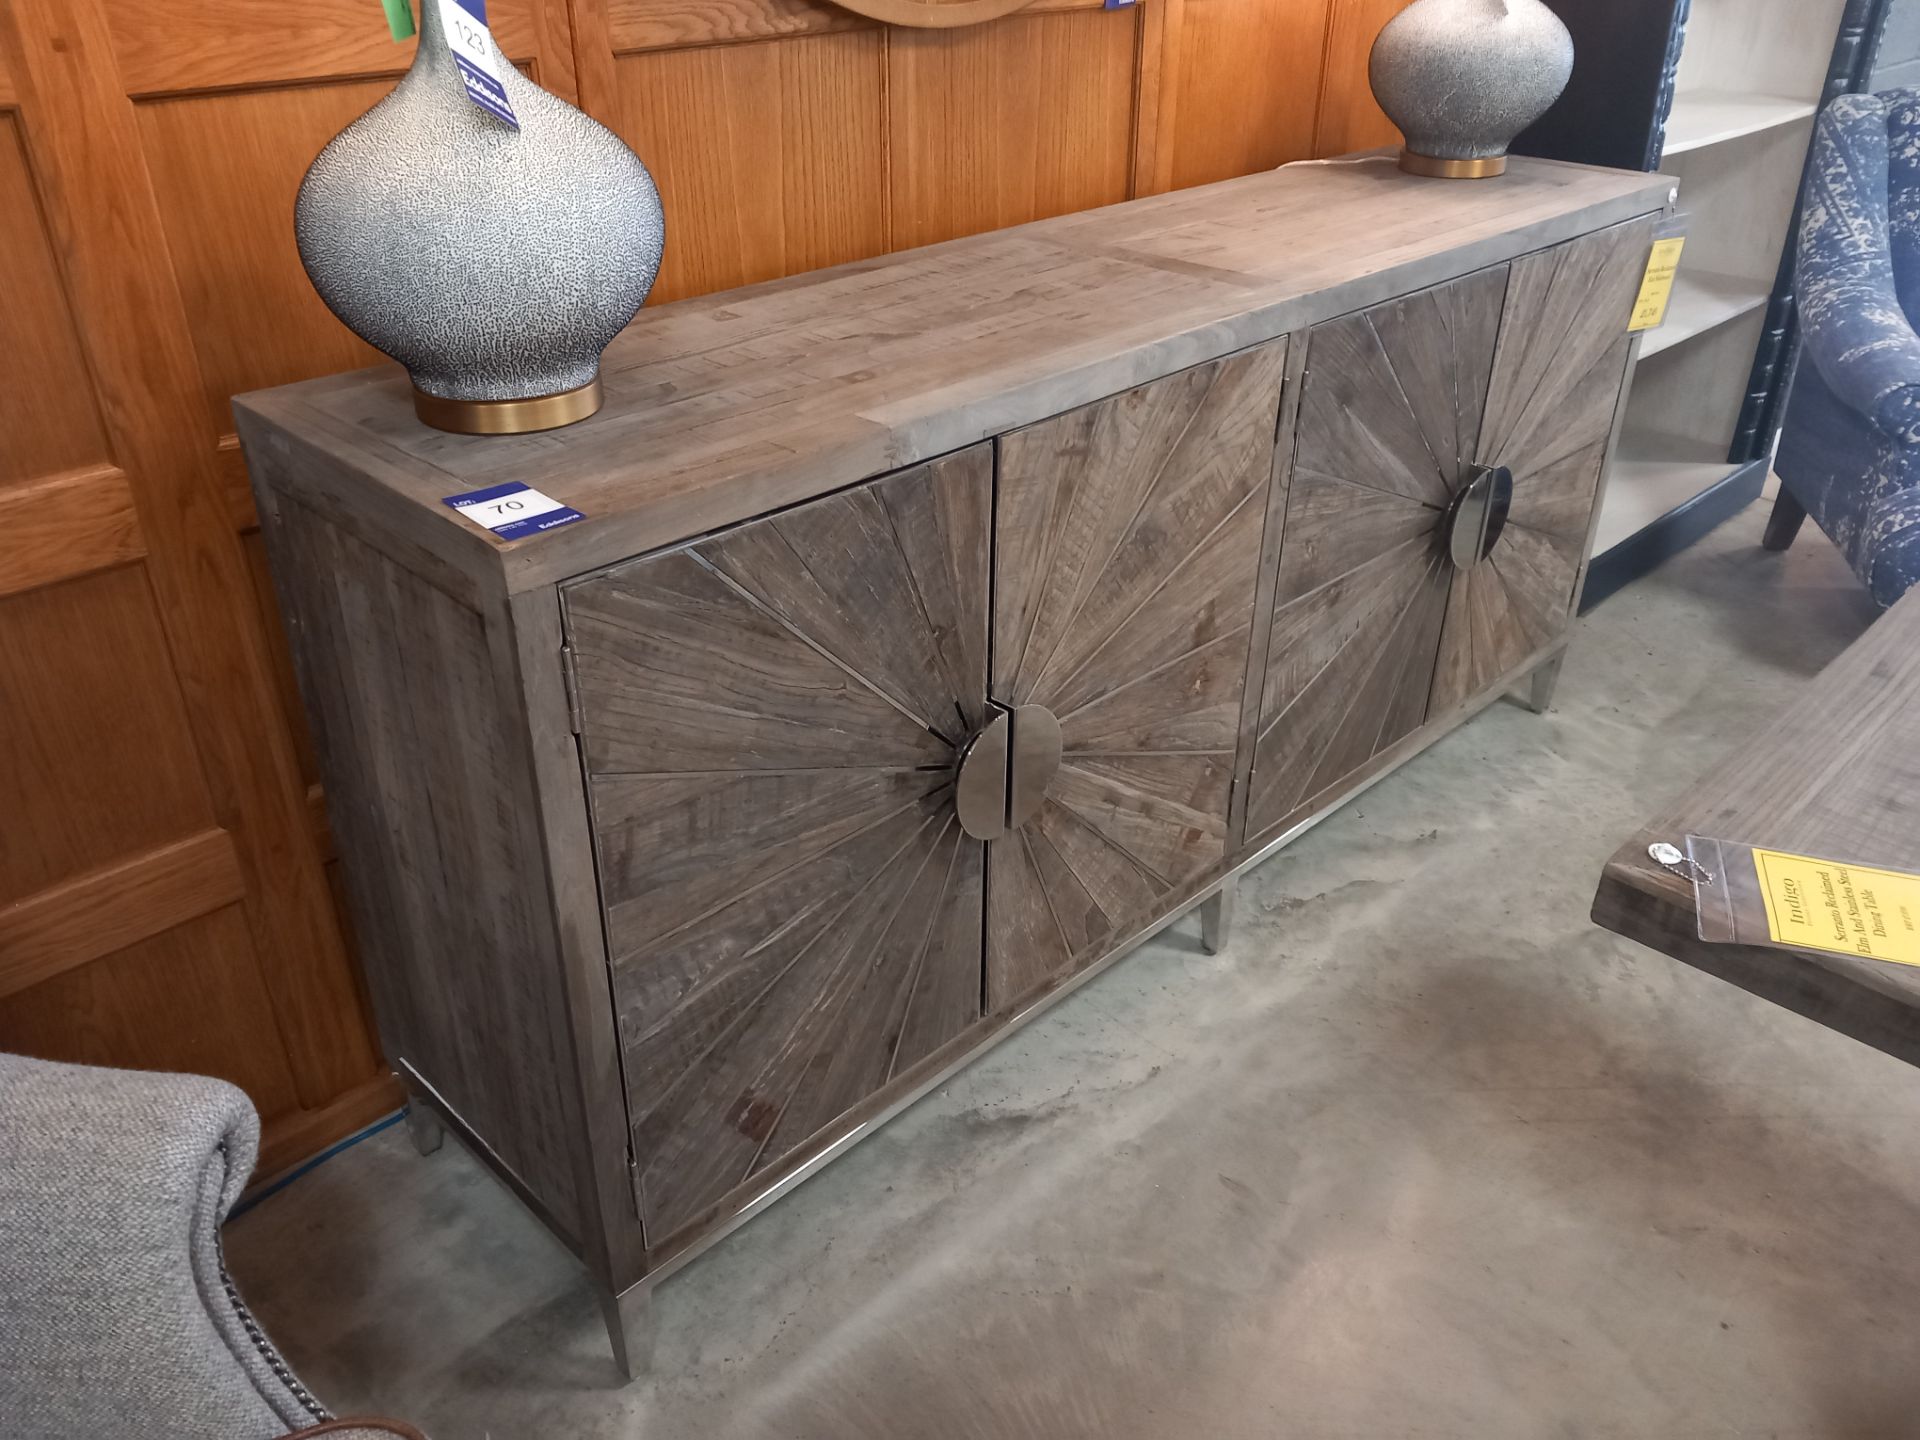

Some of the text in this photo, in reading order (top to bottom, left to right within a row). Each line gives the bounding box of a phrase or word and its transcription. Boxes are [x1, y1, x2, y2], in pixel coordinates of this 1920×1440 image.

[455, 20, 485, 56] 123
[488, 500, 524, 514] 70
[1783, 878, 1805, 925] Indigo
[1816, 871, 1838, 908] Reclaimed
[1834, 866, 1872, 954] Elm And Stainless Steel
[1860, 889, 1887, 938] Dining Table
